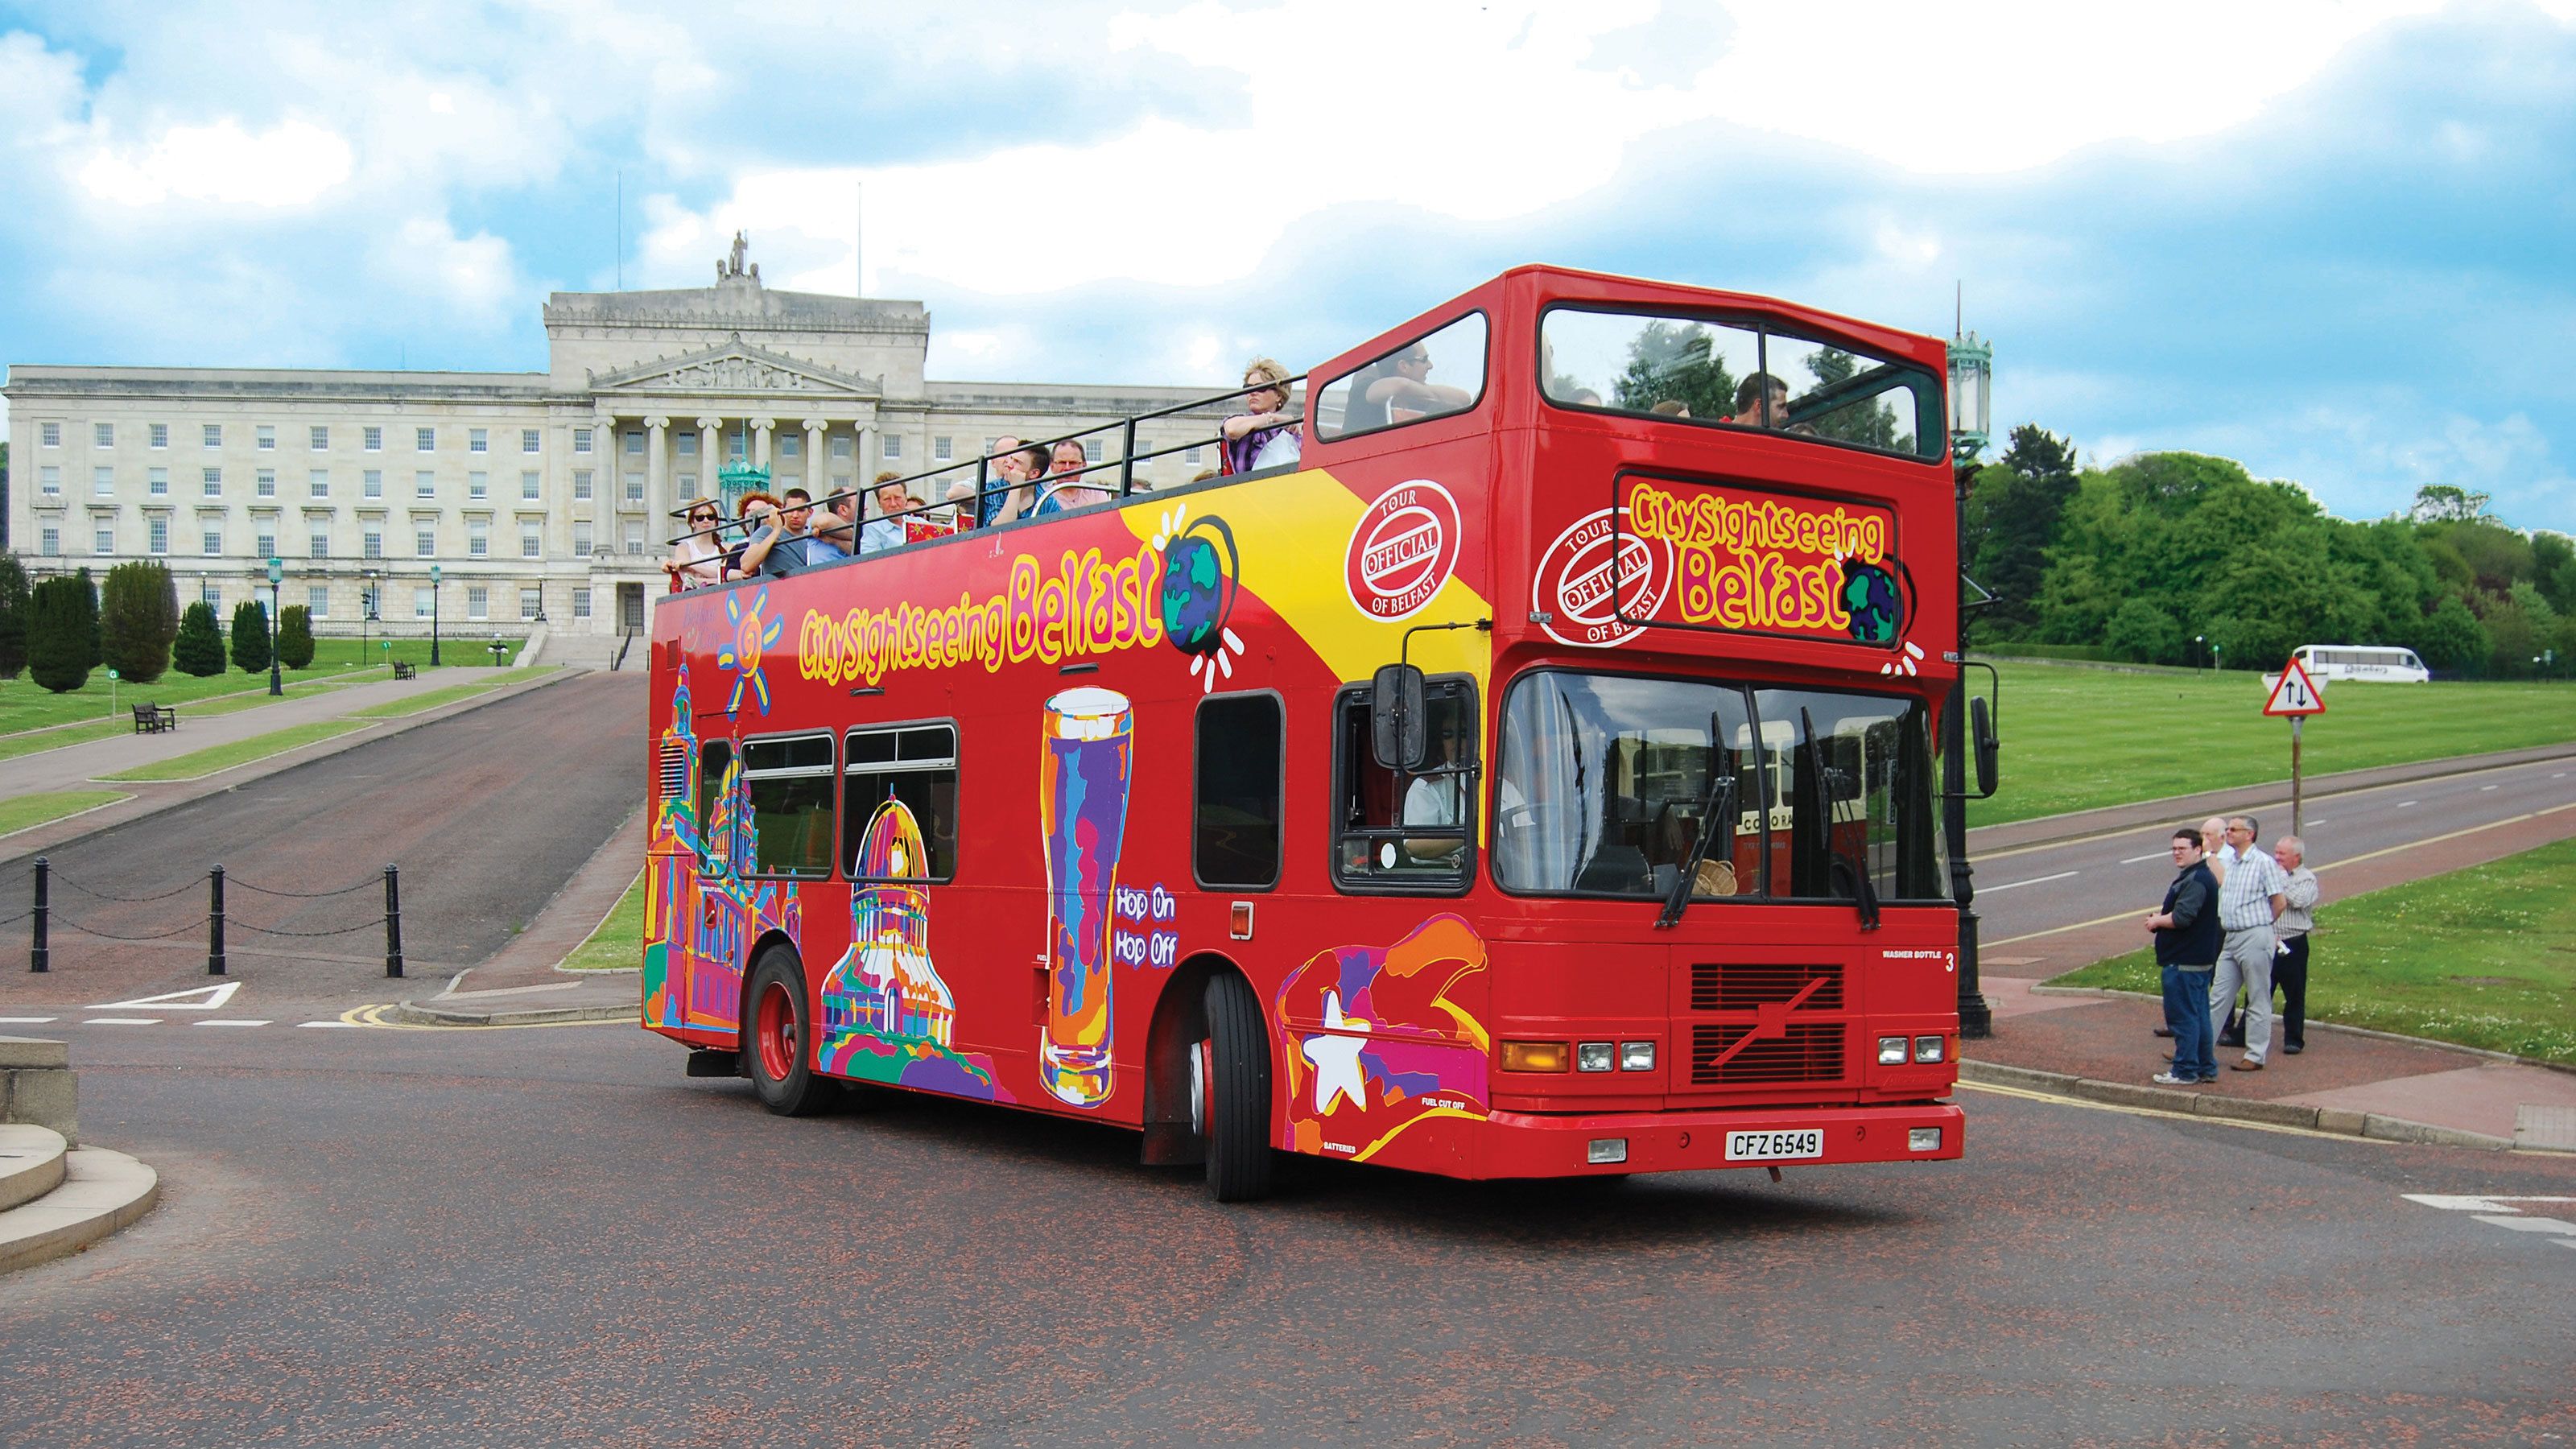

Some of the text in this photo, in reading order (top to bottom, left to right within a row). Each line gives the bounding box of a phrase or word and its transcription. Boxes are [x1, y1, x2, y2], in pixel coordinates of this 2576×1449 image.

[1380, 489, 1417, 518] TOUR
[1365, 528, 1437, 576] OFFICIAL
[1565, 519, 1612, 553] TOUR
[1372, 572, 1437, 614] OF BELFAST
[1678, 542, 1852, 630] Belfast
[1008, 545, 1164, 665] Belfast
[1587, 586, 1657, 642] OF BEFAST
[1116, 885, 1175, 923] Hop On
[1115, 930, 1177, 967] Hop Off
[1882, 950, 1942, 959] WASHER BOTTLE
[1945, 952, 1955, 972] 3
[1422, 1096, 1465, 1110] FUEL CUT OFF
[1323, 1141, 1356, 1154] BATTERIES
[1733, 1133, 1817, 1155] CFZ 6549
